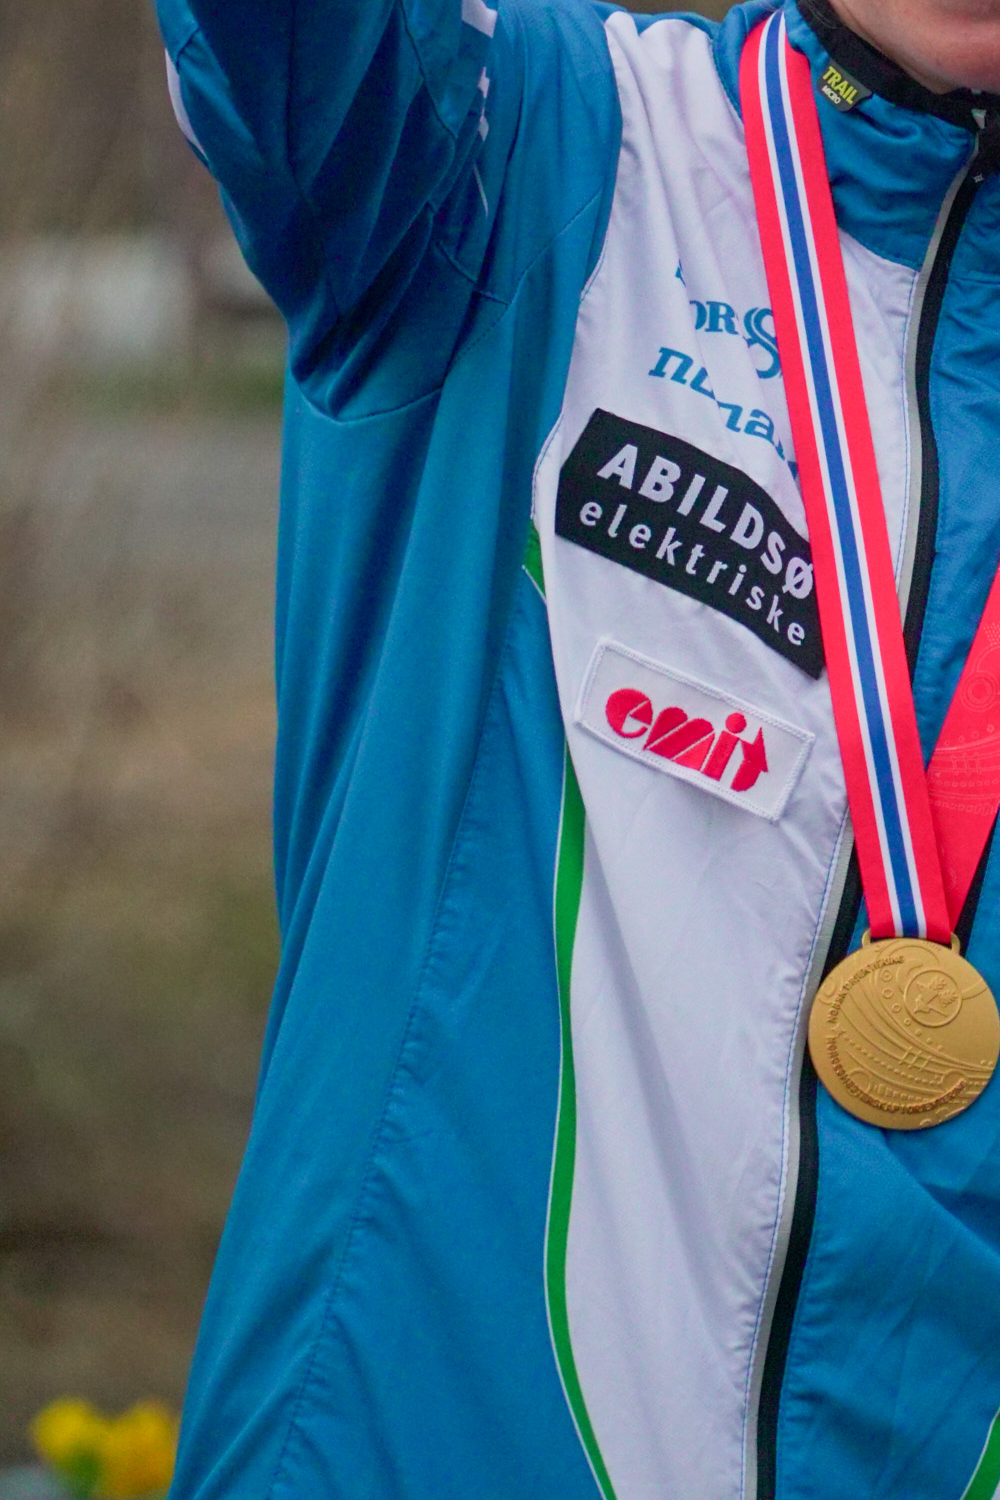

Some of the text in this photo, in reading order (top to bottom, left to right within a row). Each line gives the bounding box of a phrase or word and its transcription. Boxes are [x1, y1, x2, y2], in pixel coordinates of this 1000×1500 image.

[822, 66, 858, 105] TRAIL
[579, 501, 805, 646] elektriske
[596, 443, 813, 599] ABILDSØ
[605, 688, 769, 792] emit
